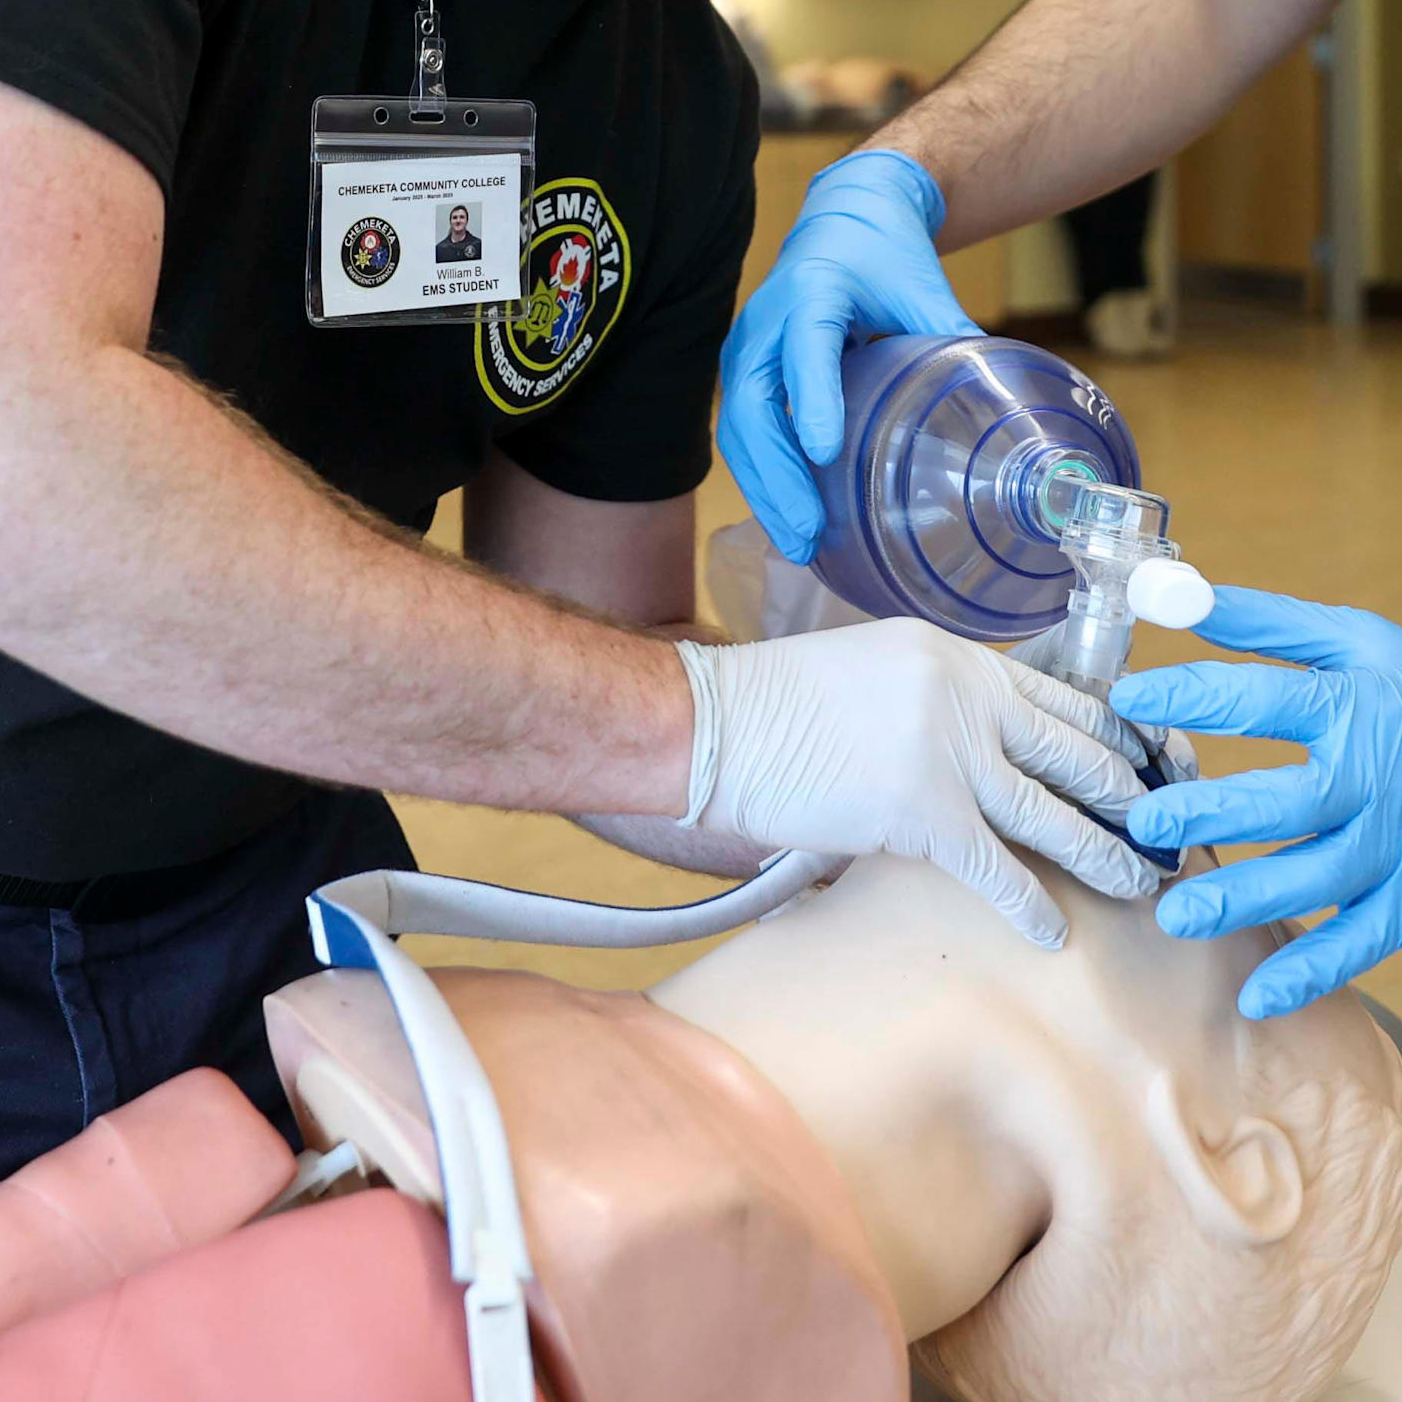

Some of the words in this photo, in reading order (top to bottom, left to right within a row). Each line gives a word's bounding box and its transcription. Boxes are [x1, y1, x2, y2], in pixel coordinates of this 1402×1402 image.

[338, 183, 397, 196] CHEMEKETA
[399, 179, 459, 193] COMMUNITY
[461, 176, 506, 188] COLLEGE
[344, 218, 397, 247] CHEMEKETA
[520, 192, 620, 293] HEMEKETA
[437, 267, 472, 280] William
[474, 266, 485, 277] B.
[422, 284, 446, 296] EMS
[449, 279, 500, 293] STUDENT
[487, 305, 536, 398] EMERGENCY
[533, 333, 593, 397] SERVICES
